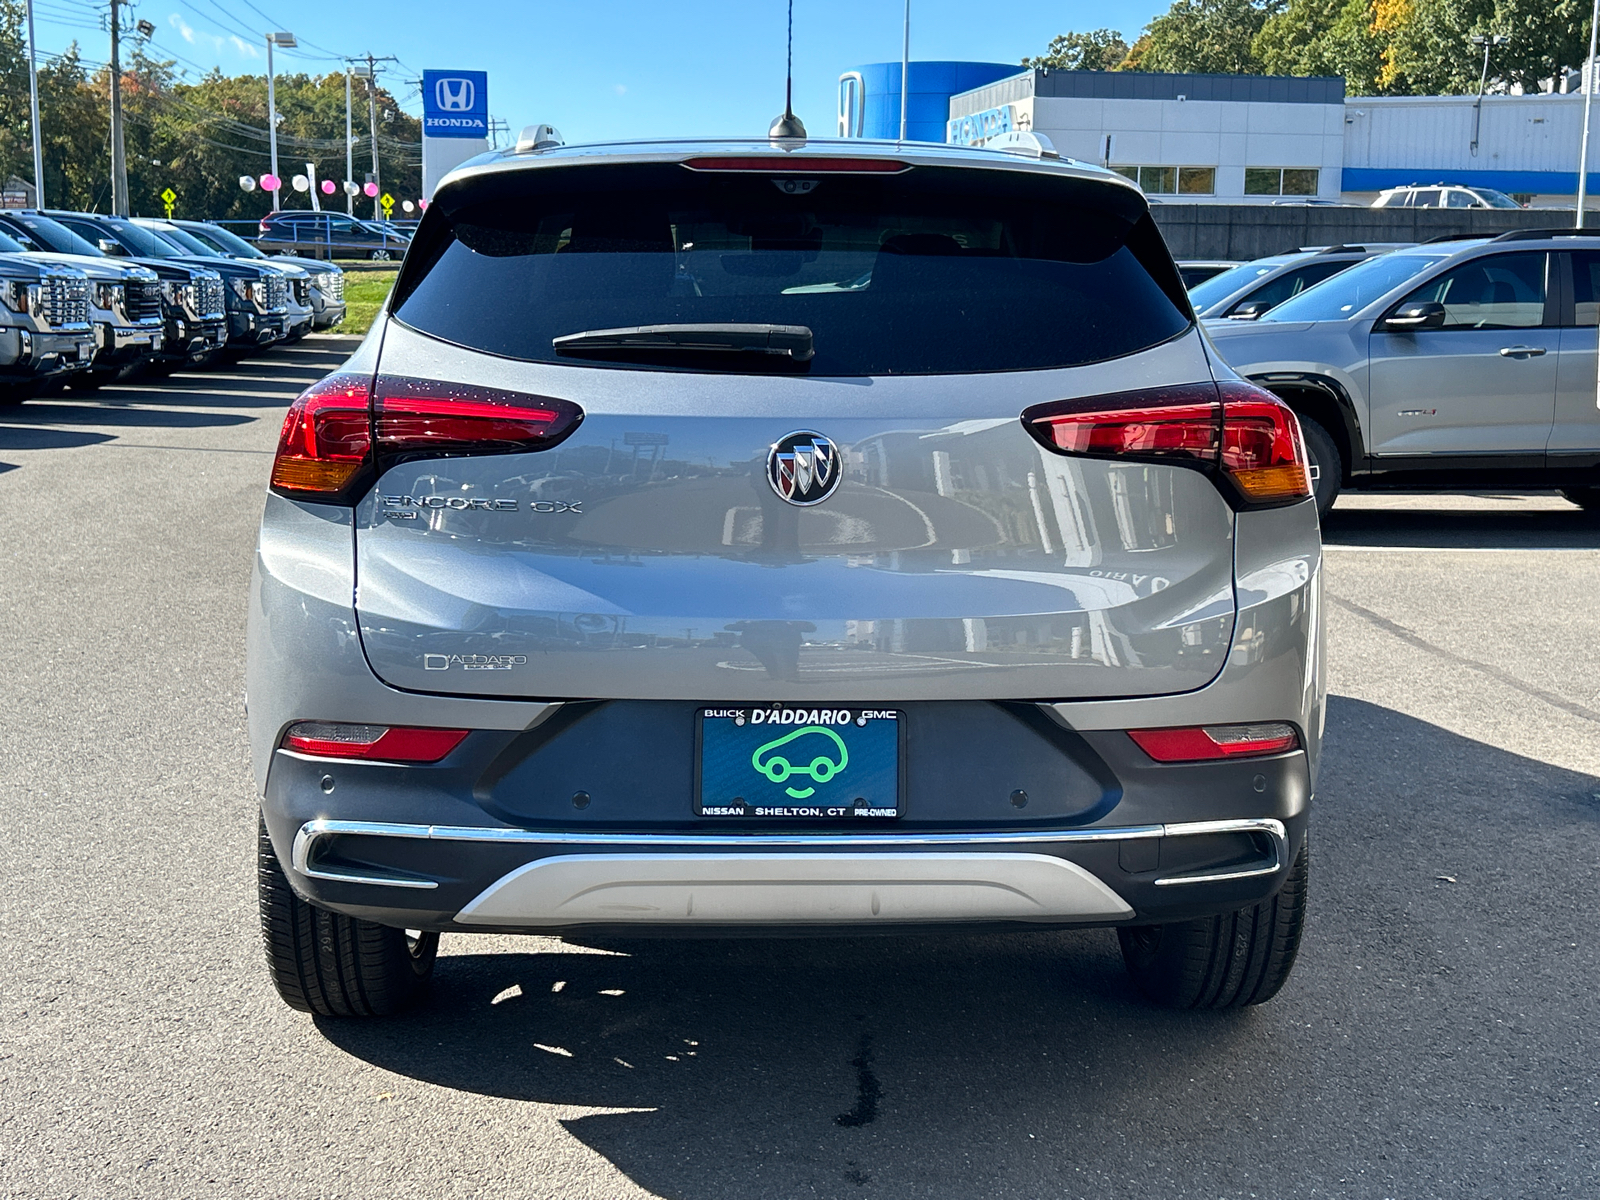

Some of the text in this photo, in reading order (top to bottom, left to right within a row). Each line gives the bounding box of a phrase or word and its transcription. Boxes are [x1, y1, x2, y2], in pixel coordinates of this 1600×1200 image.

[426, 117, 485, 128] HONDA
[950, 105, 1014, 145] HONDA
[383, 495, 583, 514] ENCORE GX
[704, 709, 897, 725] BUICK D'ADDARIO GMC
[702, 807, 897, 817] NISSAN SHELTON, CT PRE-OWNED
